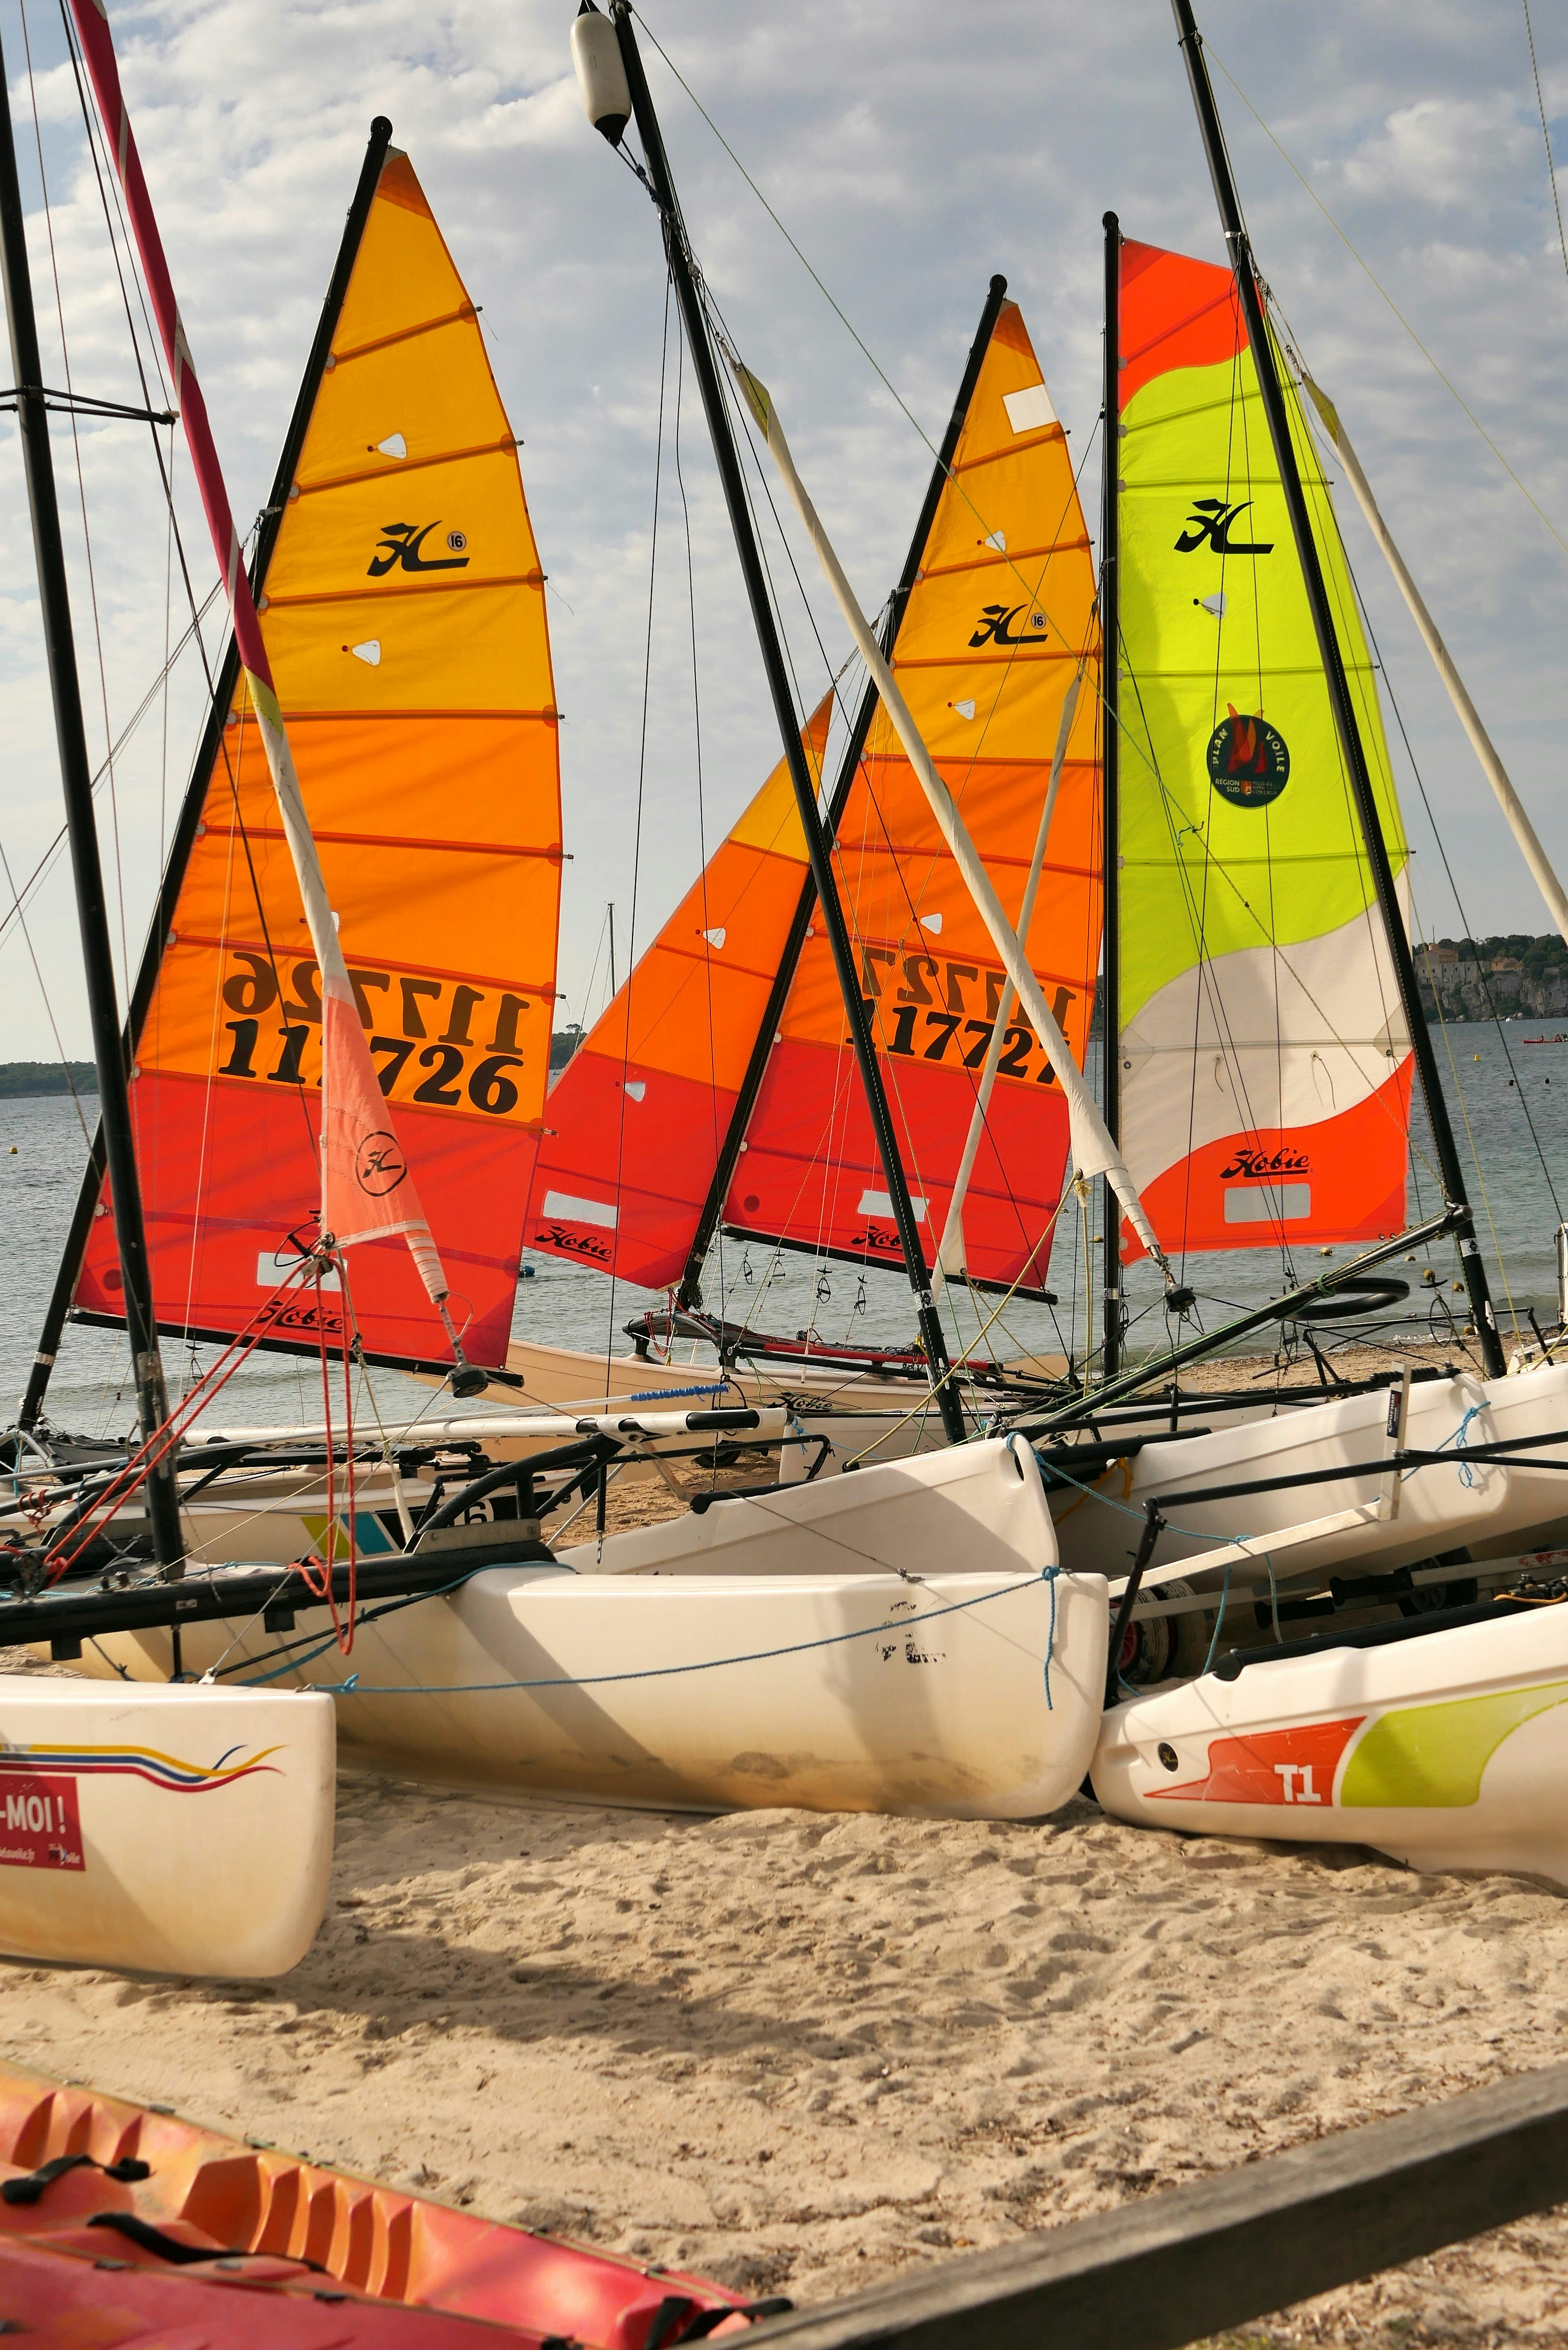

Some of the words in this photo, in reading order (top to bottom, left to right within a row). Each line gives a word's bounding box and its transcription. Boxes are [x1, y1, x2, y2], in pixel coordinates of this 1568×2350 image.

[451, 535, 463, 548] 16
[1034, 616, 1043, 626] 16
[1213, 728, 1228, 765] PLAN
[1266, 731, 1285, 773] VOILE
[218, 1018, 524, 1115] 11726
[1219, 1148, 1311, 1179] Hobie
[534, 1225, 612, 1263] Hobie
[1274, 1764, 1321, 1802] T1
